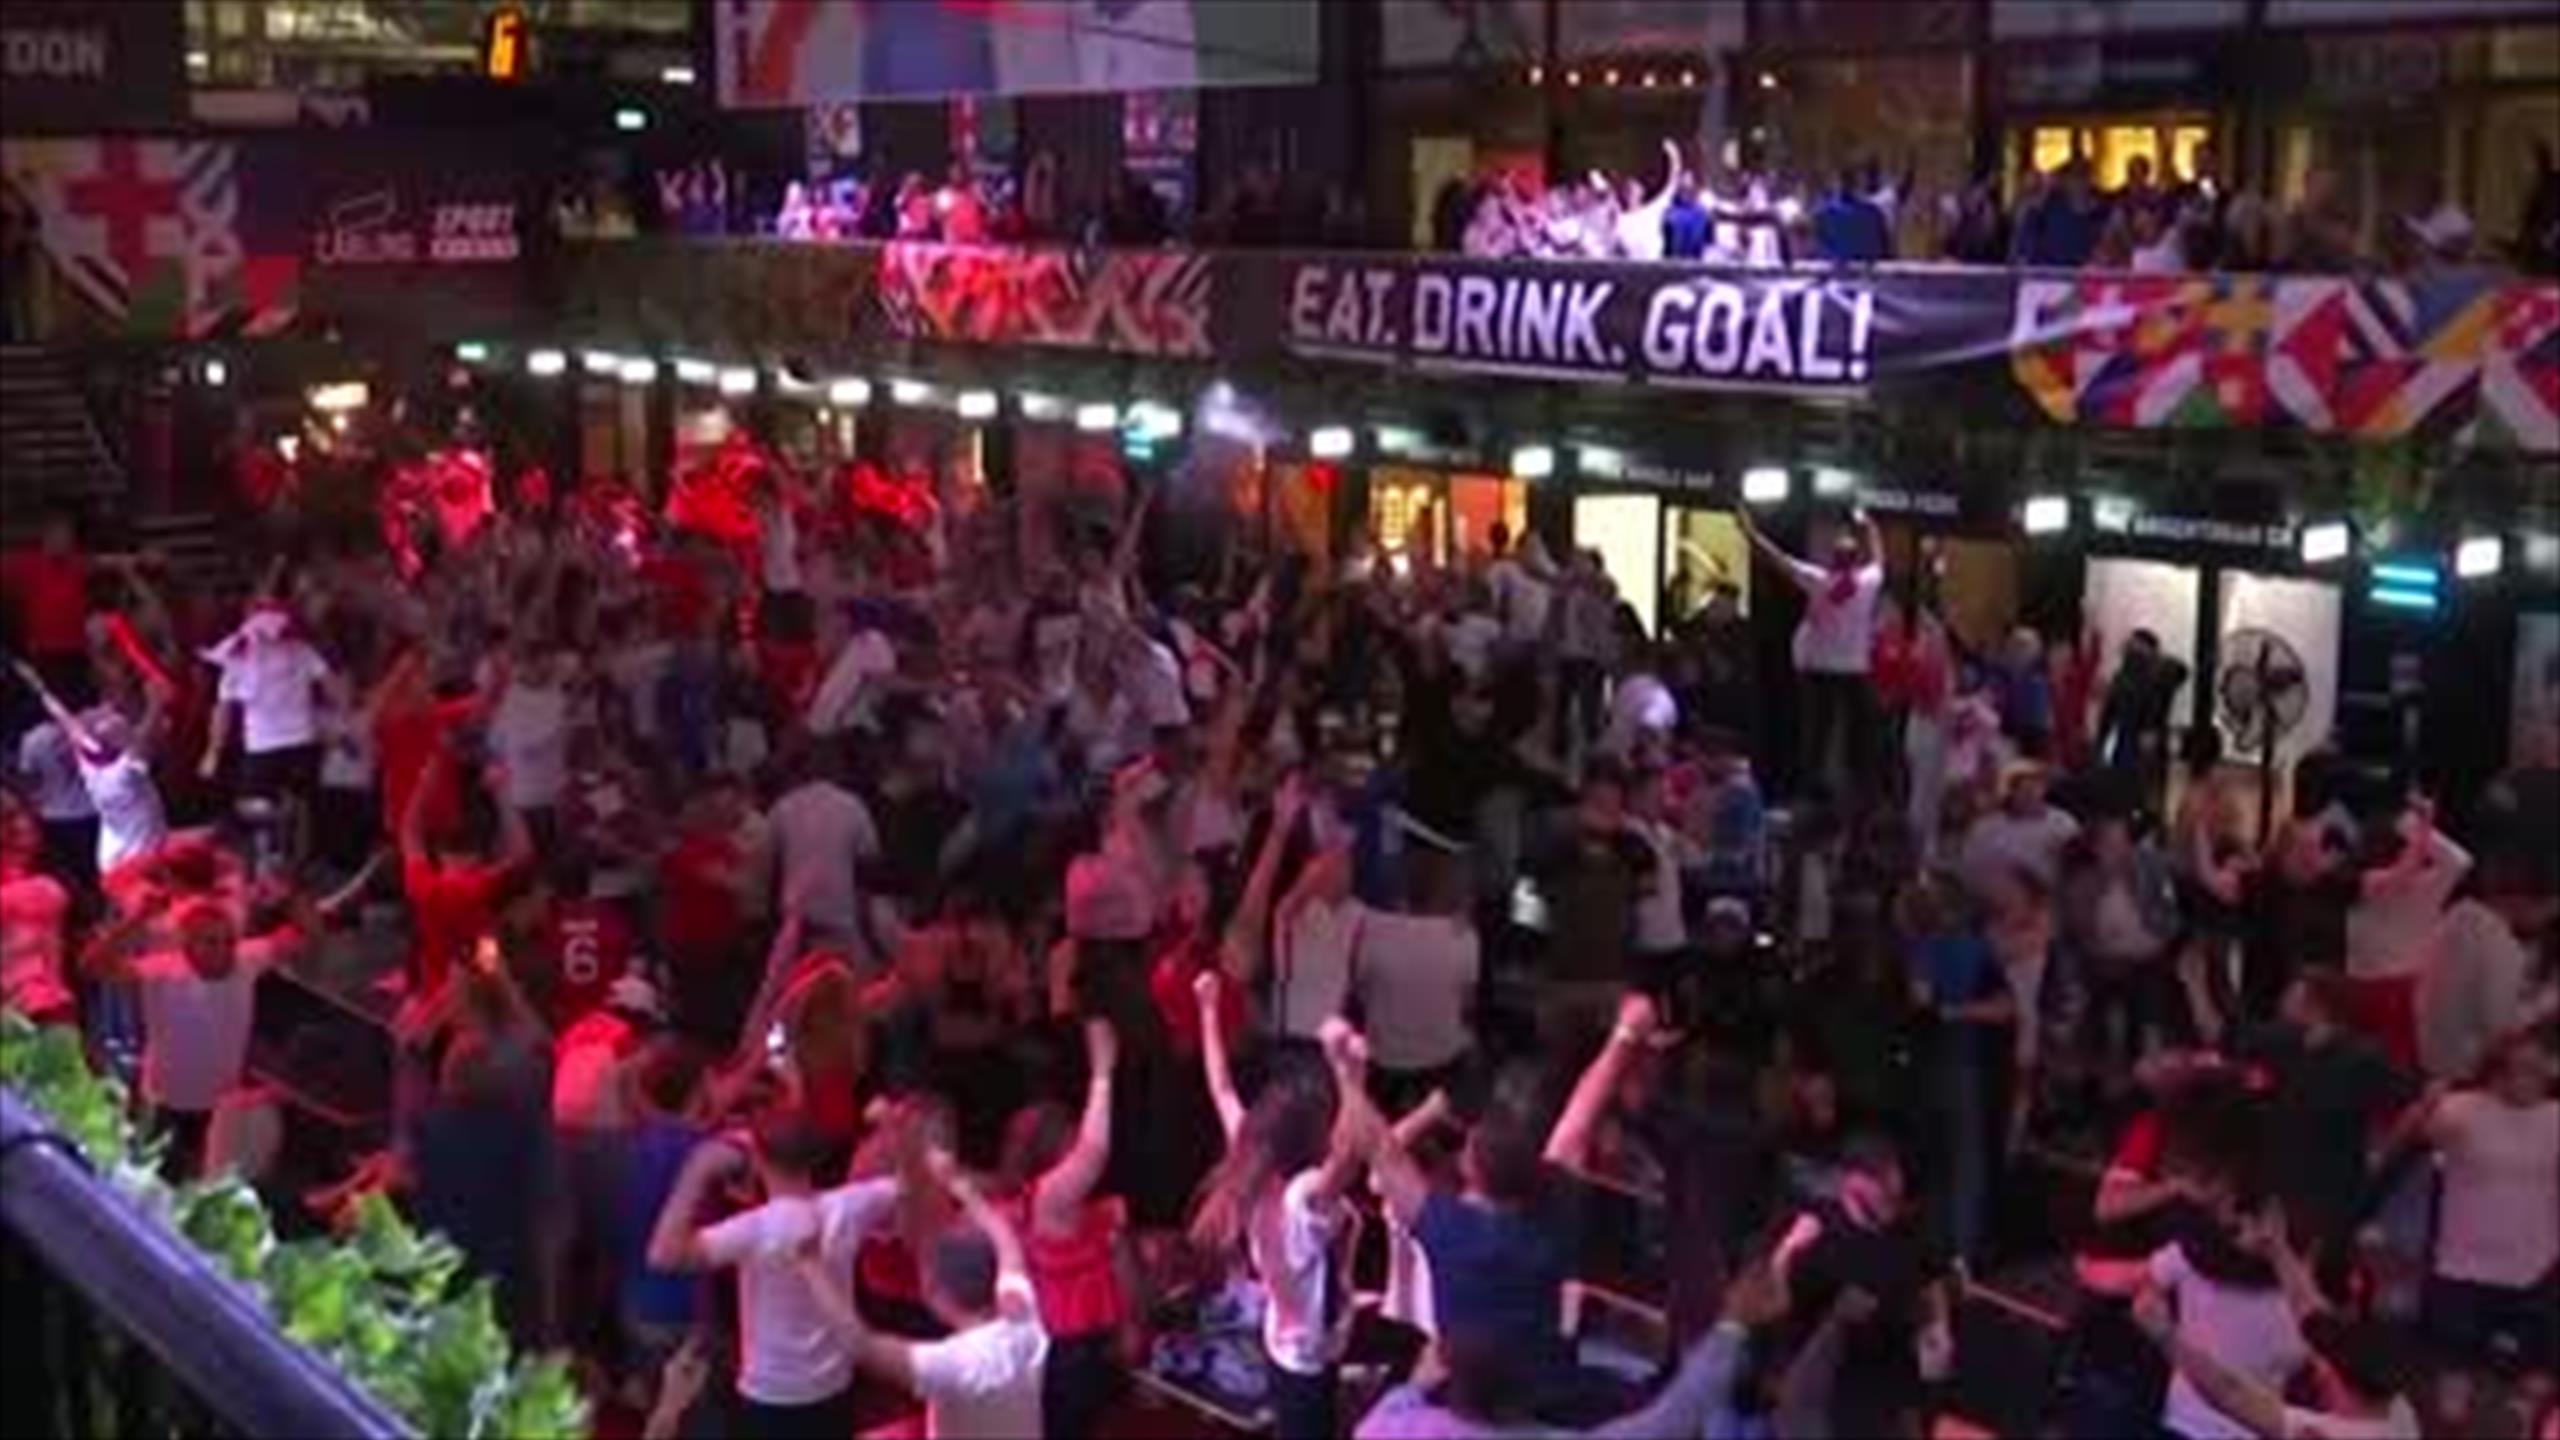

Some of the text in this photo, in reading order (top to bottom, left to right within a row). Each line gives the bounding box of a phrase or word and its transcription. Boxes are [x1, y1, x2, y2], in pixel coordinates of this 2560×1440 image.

[1291, 265, 1875, 381] EAT. DRINK. GOAL!
[562, 935, 601, 985] 6
